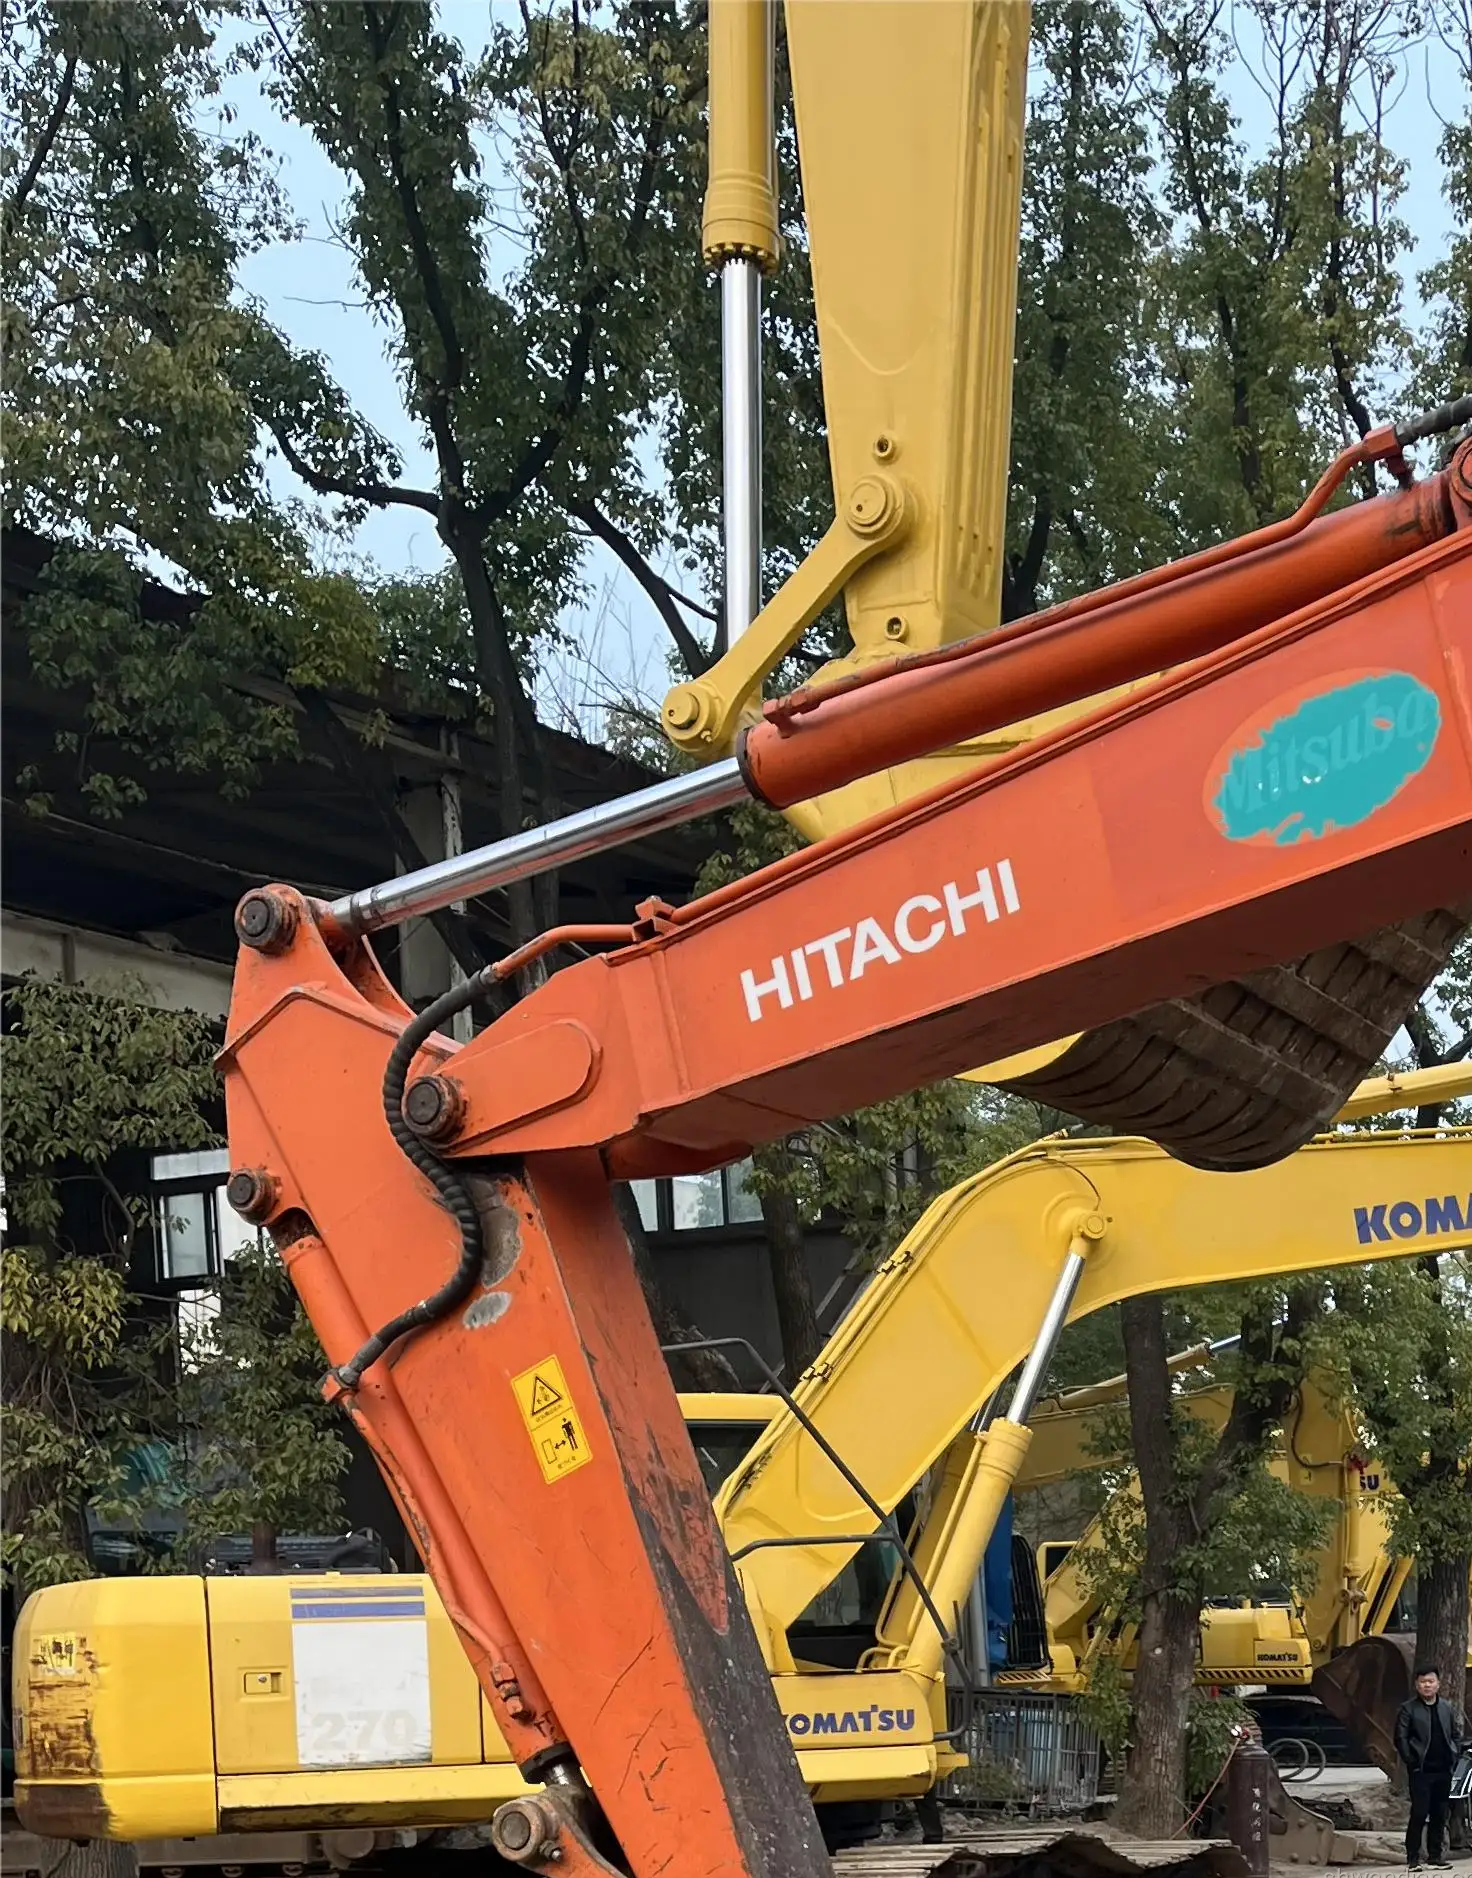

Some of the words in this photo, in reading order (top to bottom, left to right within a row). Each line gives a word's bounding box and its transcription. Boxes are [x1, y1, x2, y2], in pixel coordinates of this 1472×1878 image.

[740, 858, 1020, 1022] HITACHI
[1257, 1651, 1298, 1662] KOMATSU
[311, 1709, 418, 1750] 270
[783, 1704, 915, 1735] OMATSU
